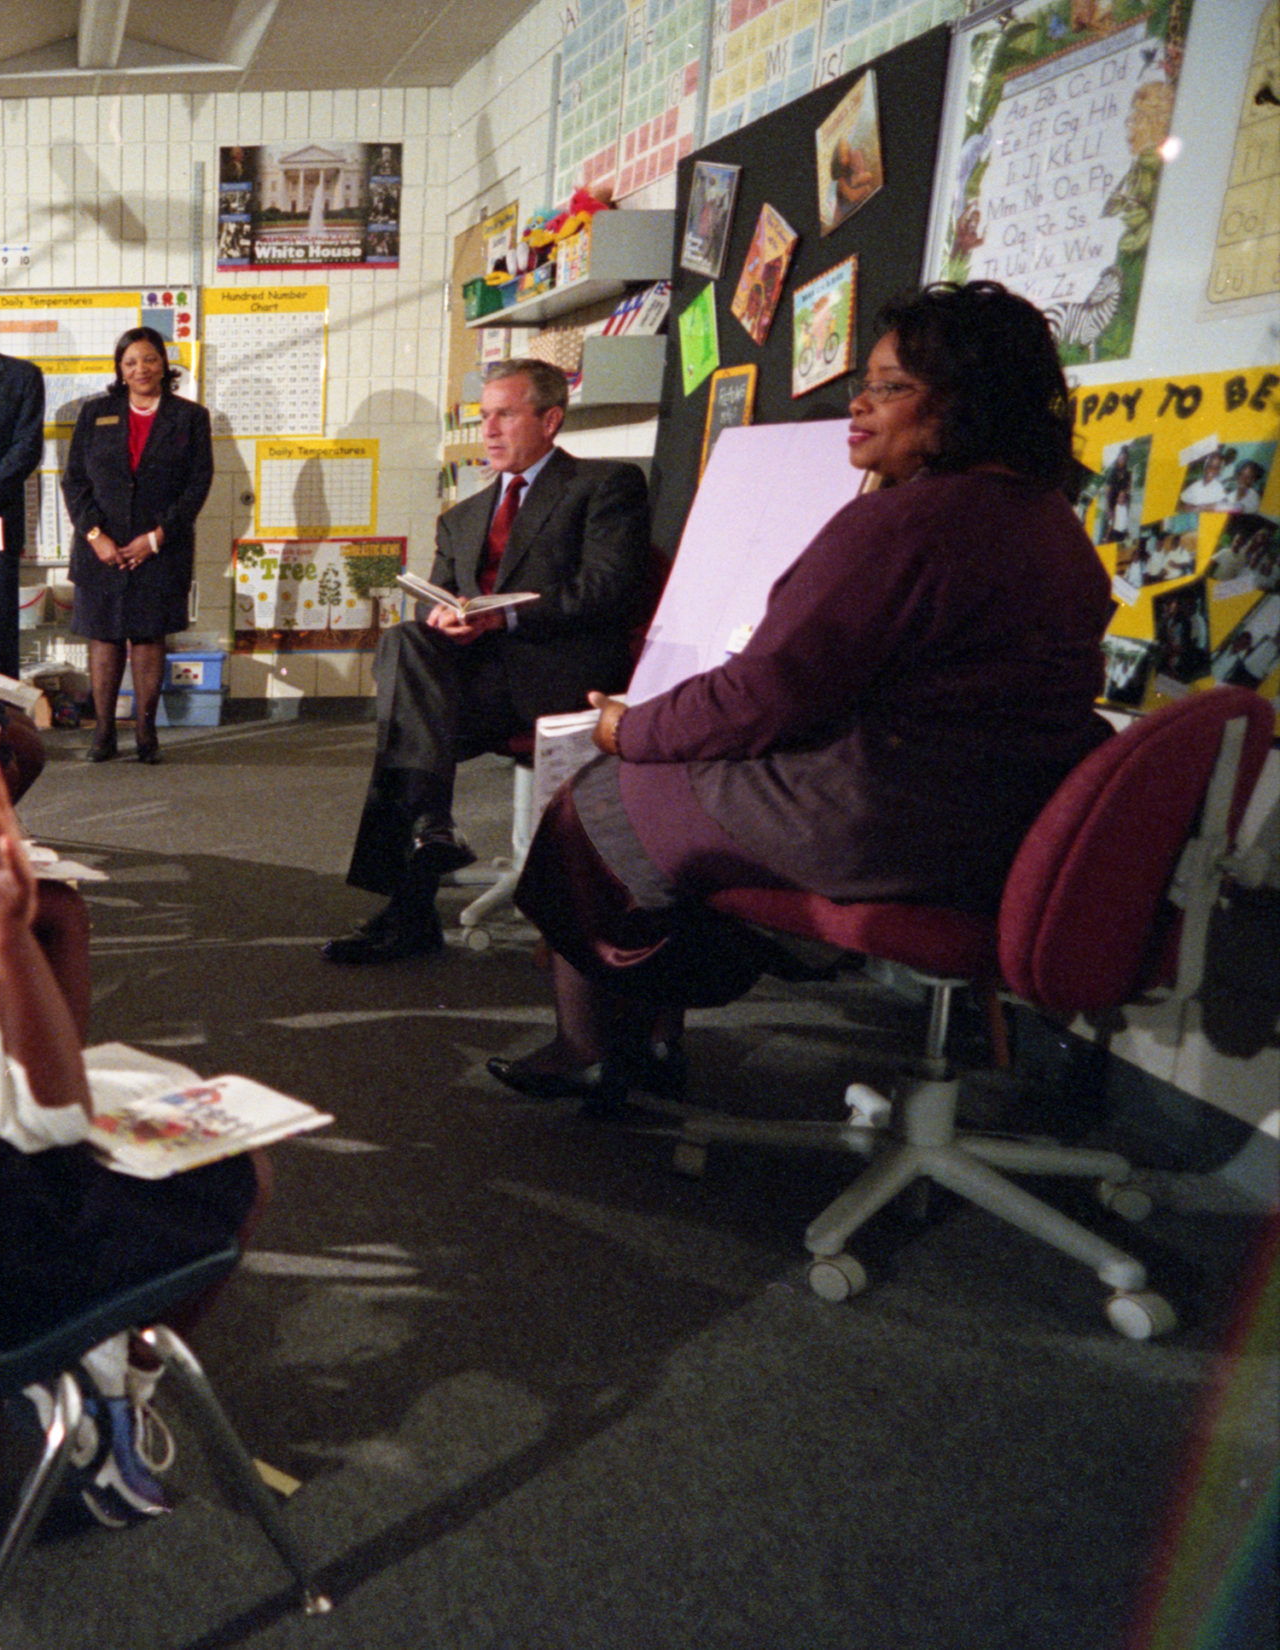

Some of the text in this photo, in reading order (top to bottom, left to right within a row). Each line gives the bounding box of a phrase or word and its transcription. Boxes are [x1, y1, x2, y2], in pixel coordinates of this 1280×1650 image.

[1068, 72, 1091, 99] Cc
[1100, 53, 1128, 88] Dd
[1053, 110, 1079, 142] Gg
[1088, 94, 1117, 126] Hh
[1089, 164, 1114, 198] Pp
[1065, 206, 1087, 232] Ss
[1, 256, 9, 266] 9
[19, 255, 31, 265] 10
[255, 245, 362, 259] White House
[1, 297, 94, 307] Daily Temperatures
[221, 291, 308, 301] Hundred Number
[250, 303, 279, 312] Chart
[1157, 382, 1203, 419] TO
[1225, 373, 1280, 412] BE
[269, 446, 366, 457] Daily Temperatures
[260, 557, 317, 581] Tree
